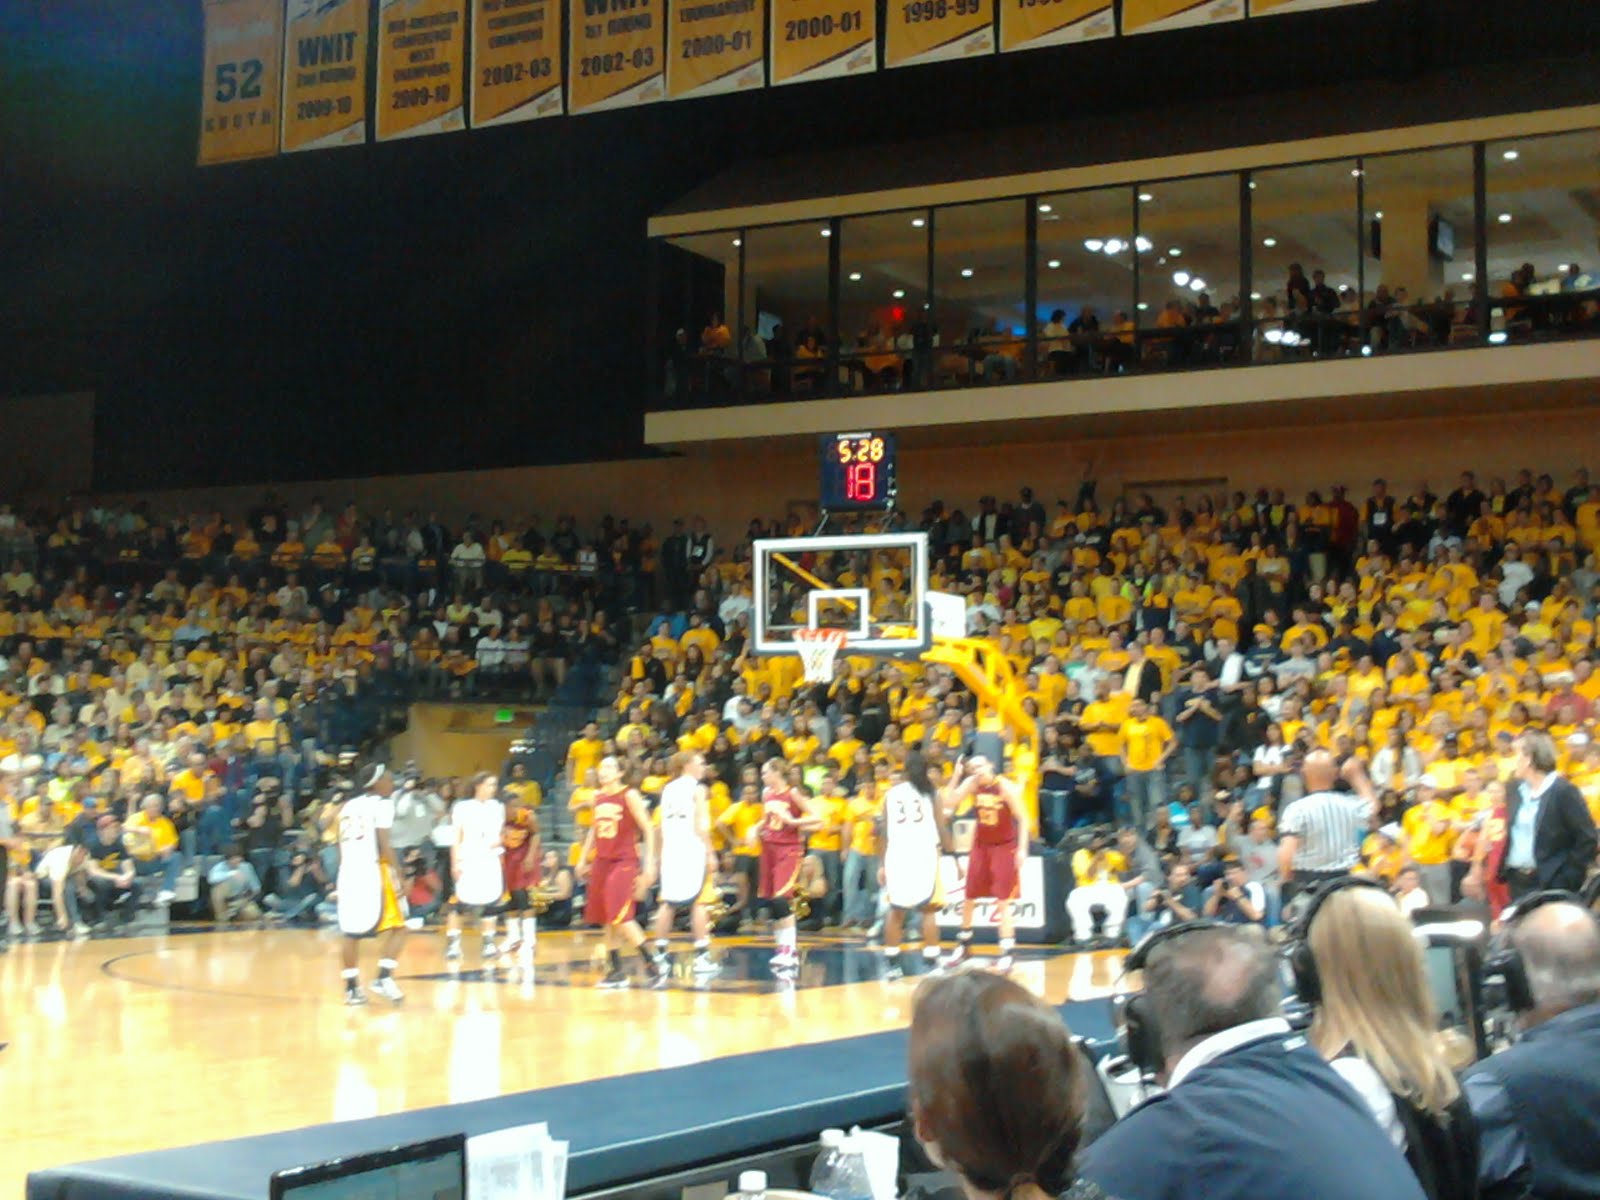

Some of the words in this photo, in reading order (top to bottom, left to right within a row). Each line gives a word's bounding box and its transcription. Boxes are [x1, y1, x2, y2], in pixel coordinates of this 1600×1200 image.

[785, 10, 862, 41] 2000-01
[903, 0, 979, 24] 1998-99
[297, 31, 358, 67] WNIT
[580, 46, 654, 77] 2002-03
[215, 58, 264, 103] 52
[482, 57, 552, 87] 2002-03
[847, 463, 875, 501] 18
[896, 799, 924, 824] 33
